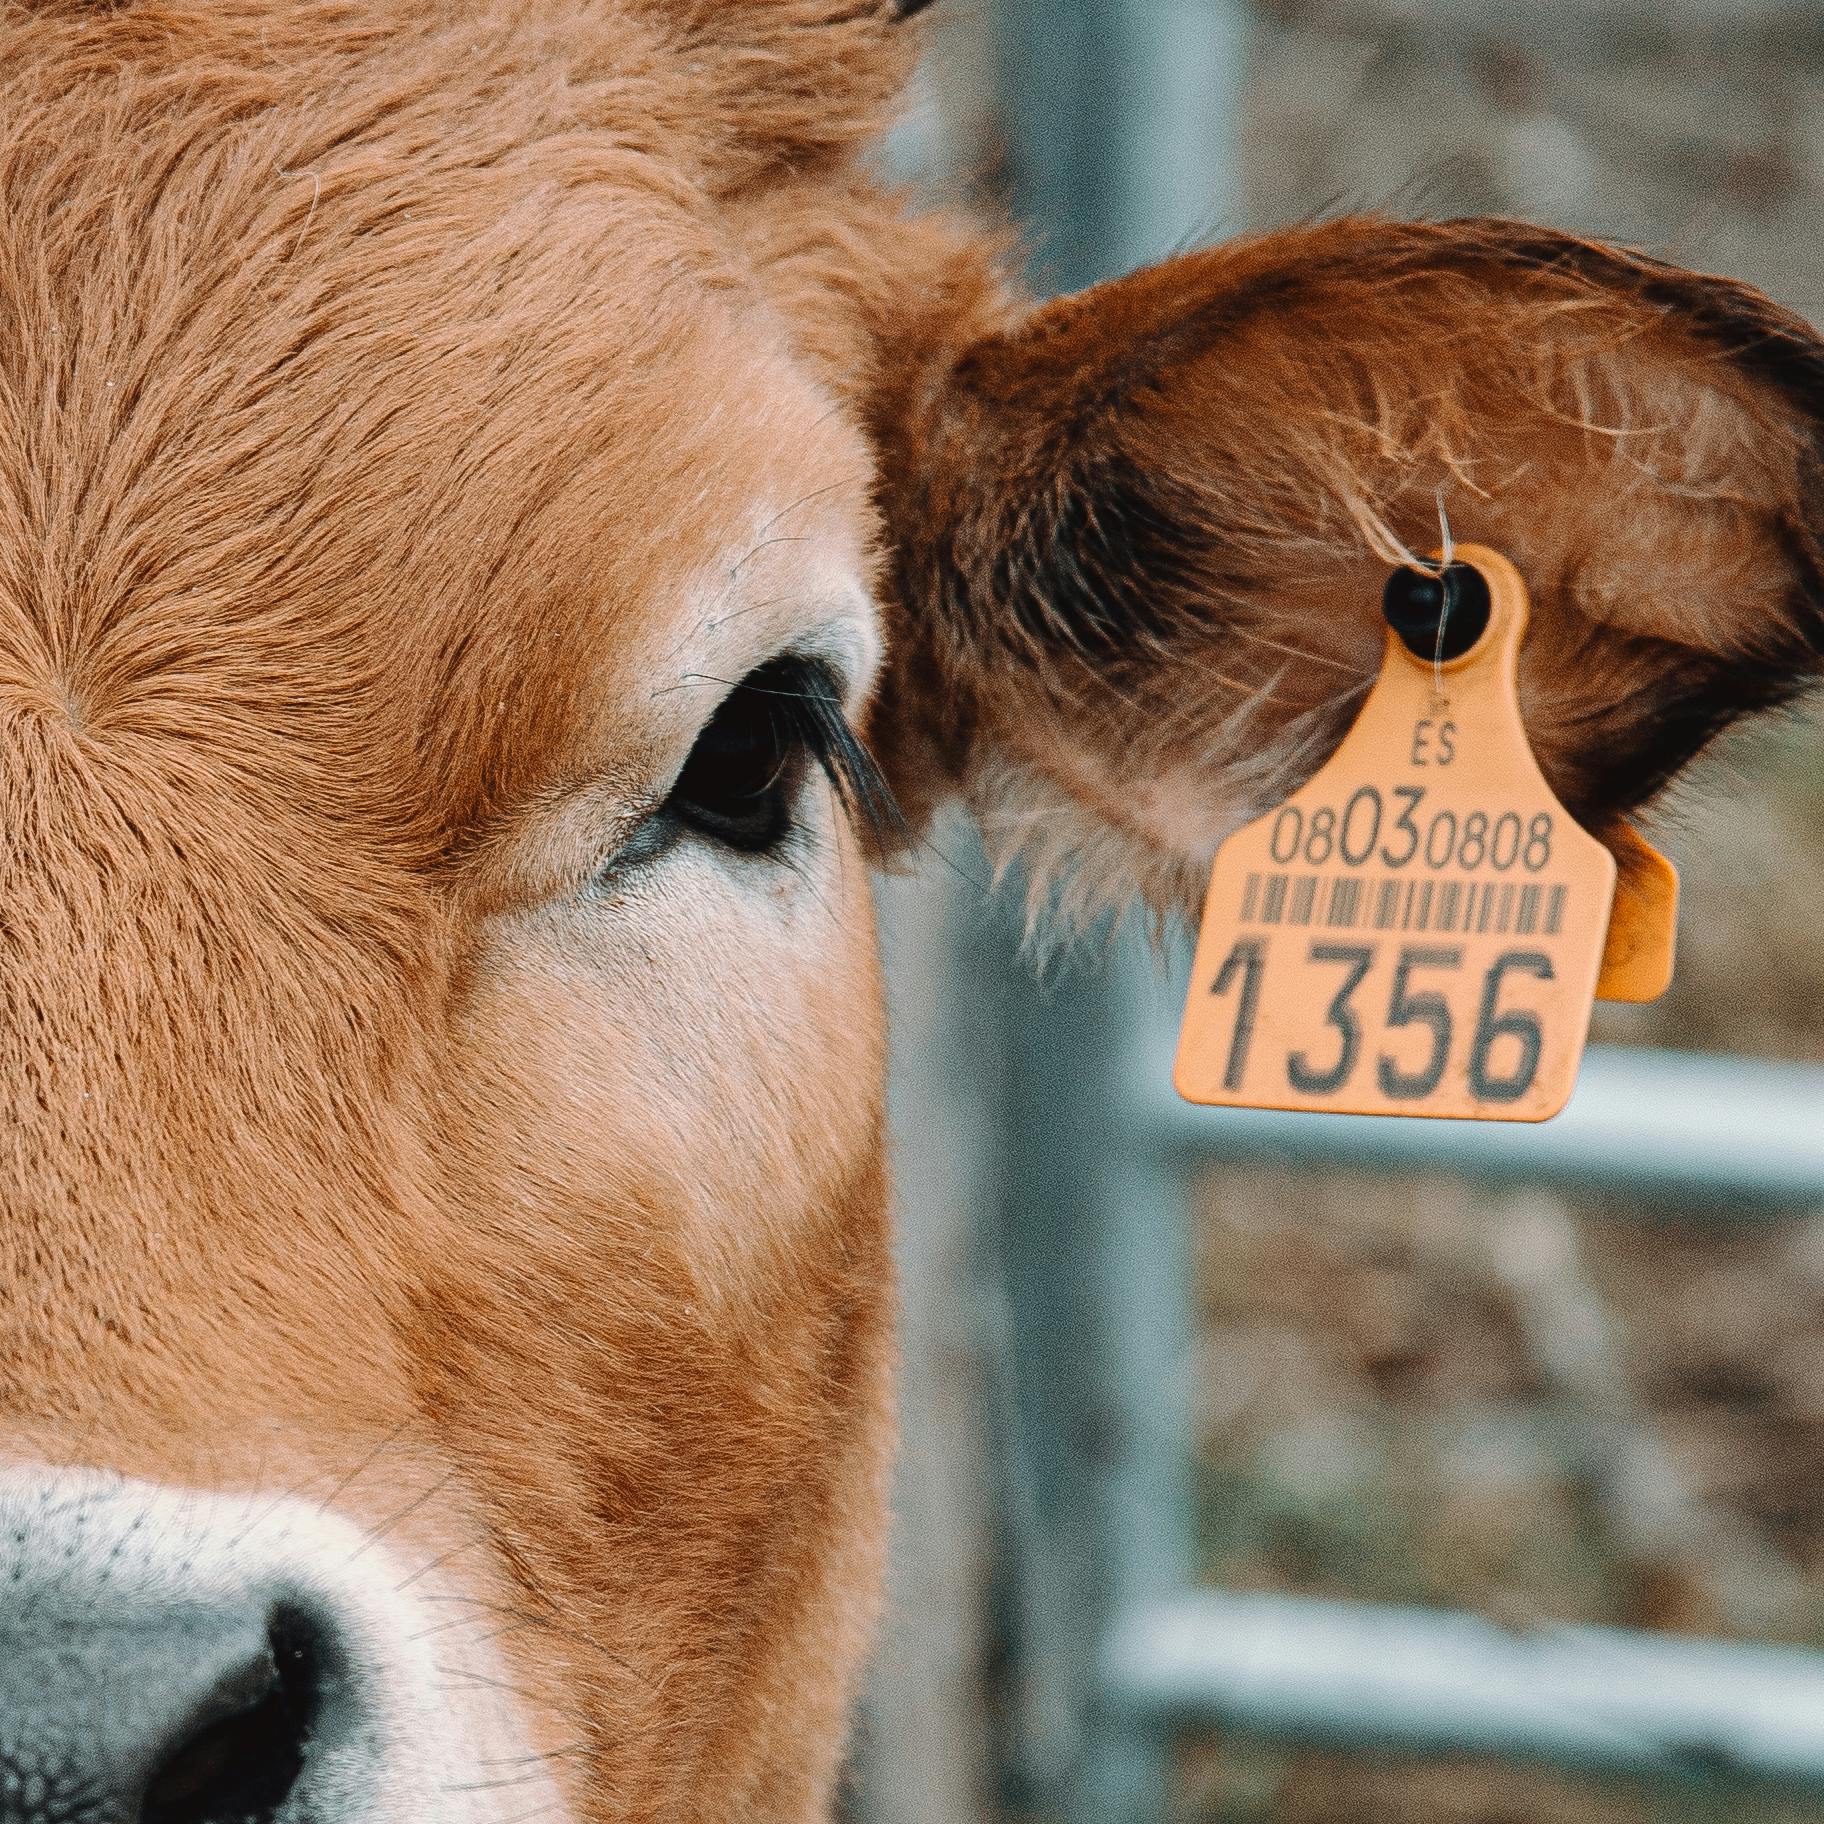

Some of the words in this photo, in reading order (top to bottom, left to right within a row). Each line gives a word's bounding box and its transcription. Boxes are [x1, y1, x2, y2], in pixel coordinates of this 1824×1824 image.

[1410, 719, 1457, 767] ES
[1270, 785, 1553, 872] 08030808
[1209, 936, 1556, 1105] 1356
